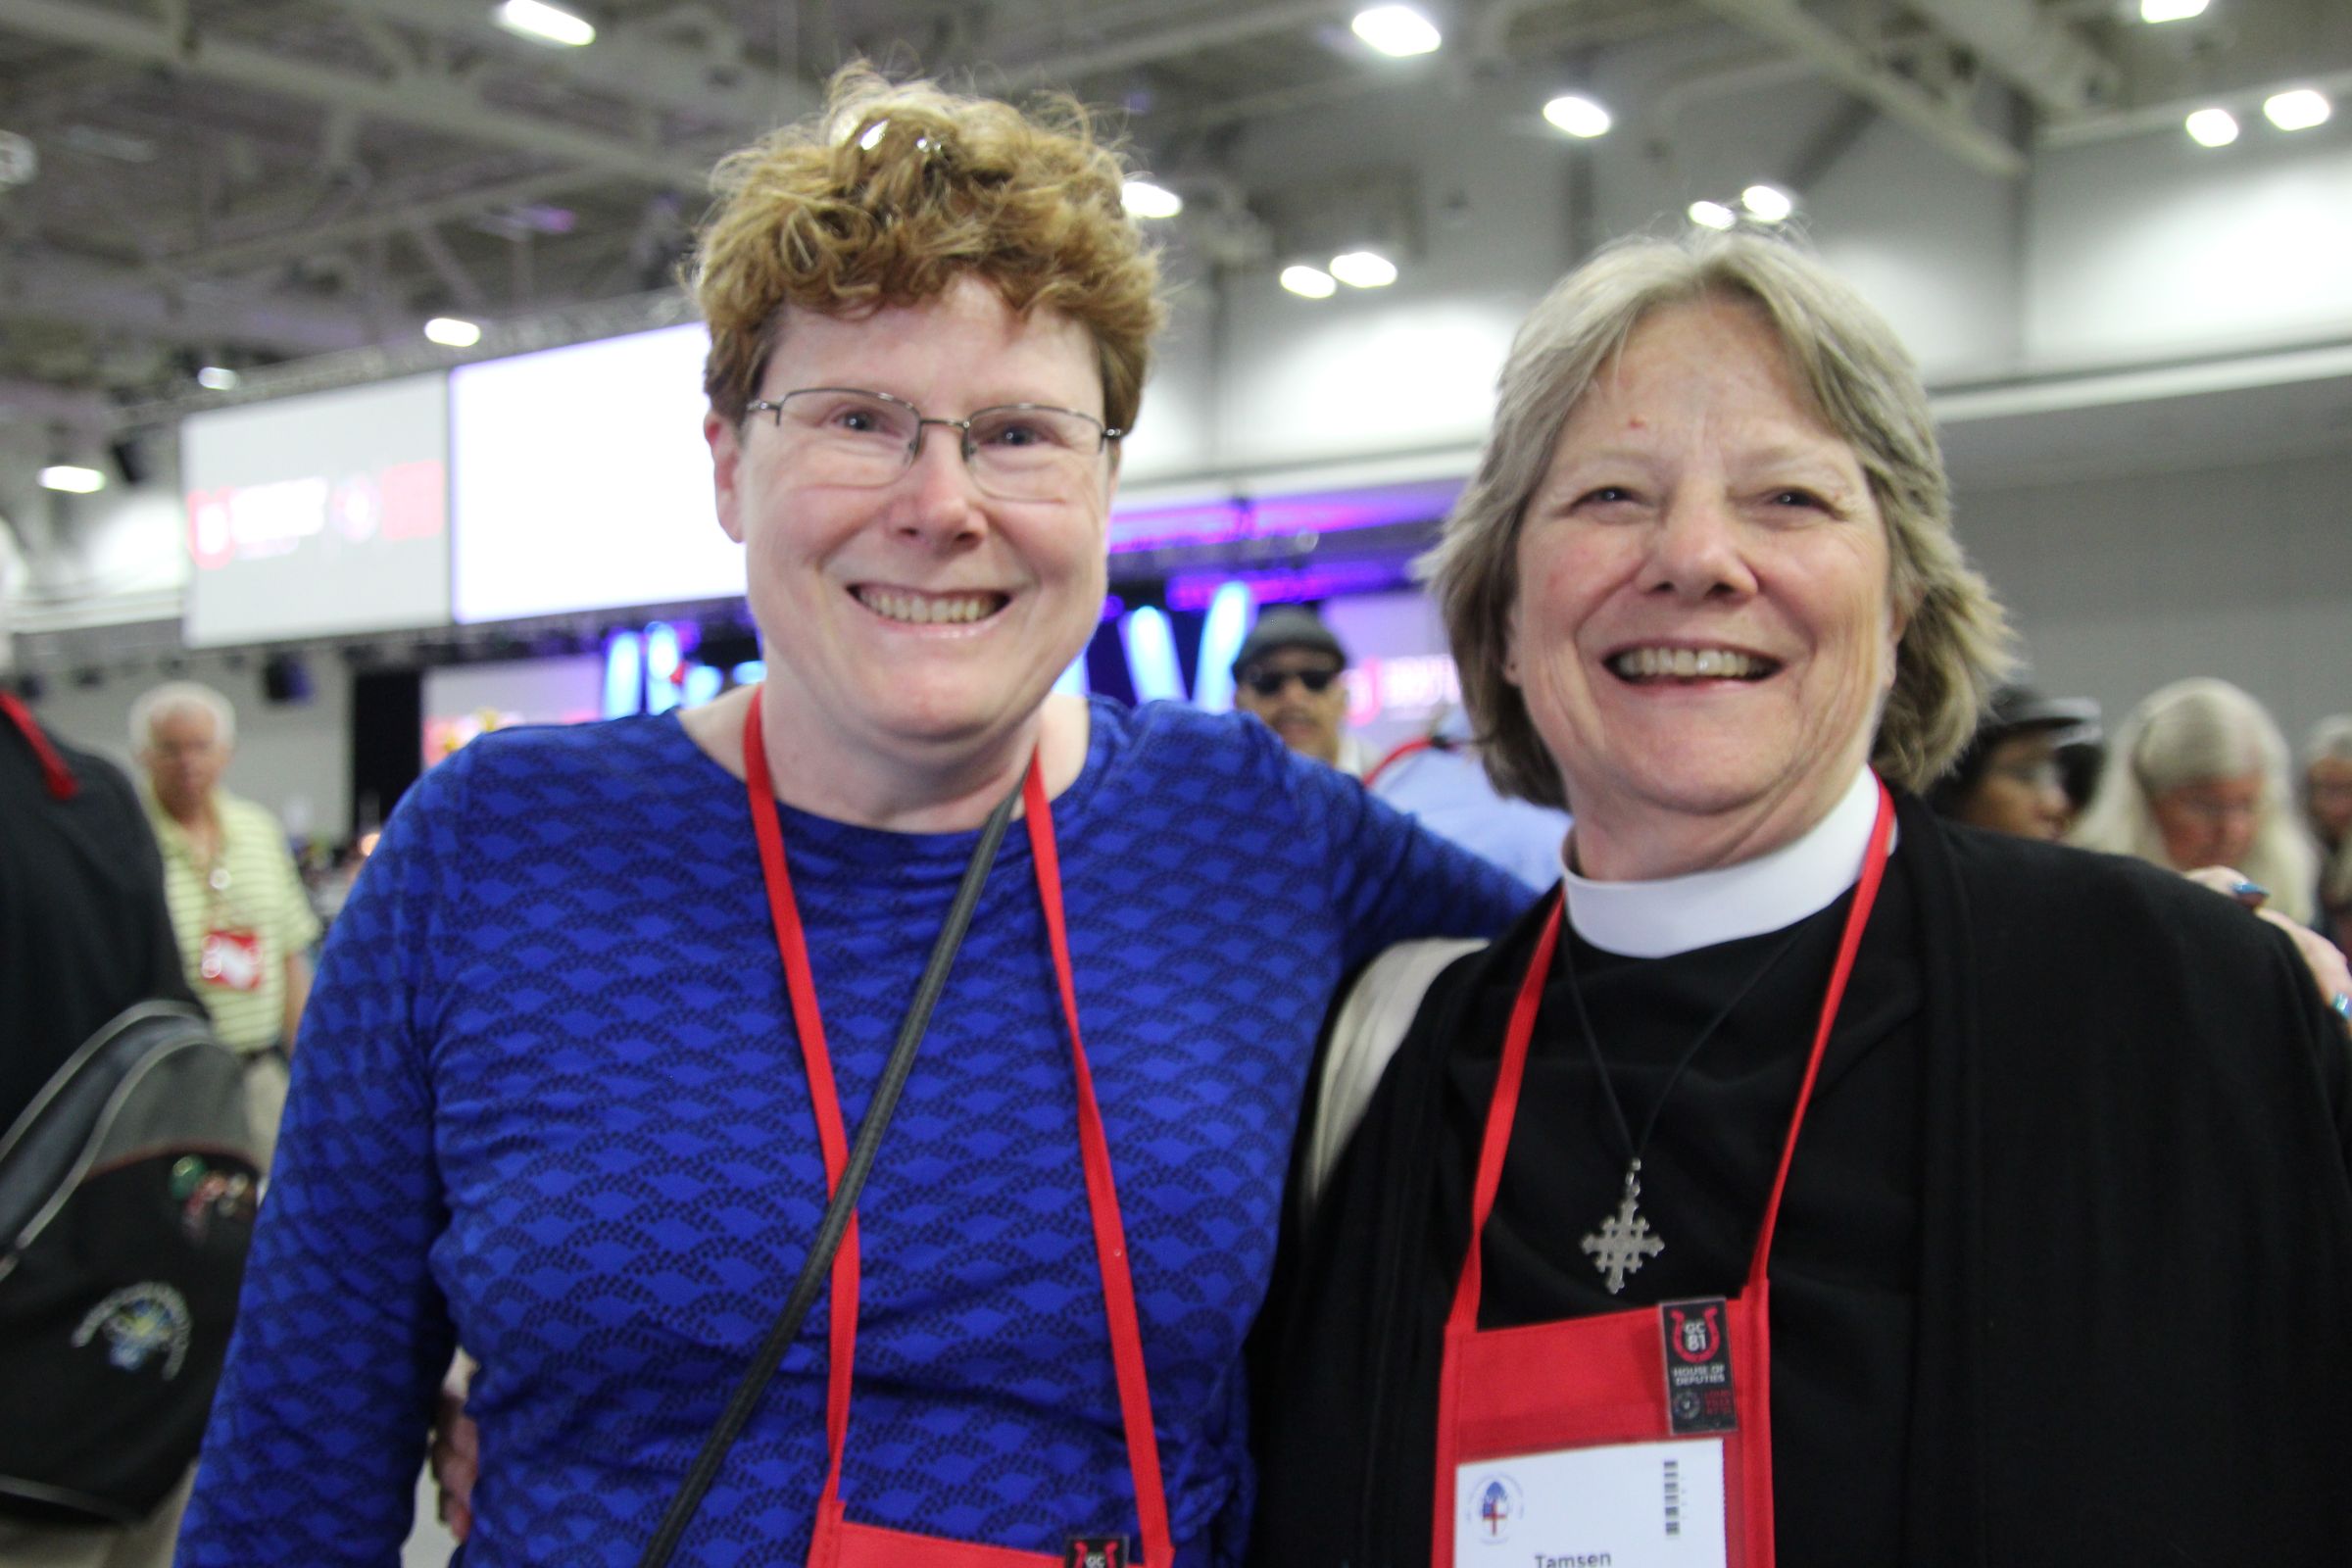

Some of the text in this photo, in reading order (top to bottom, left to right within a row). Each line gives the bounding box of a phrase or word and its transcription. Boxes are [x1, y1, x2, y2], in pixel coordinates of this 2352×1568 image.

[1685, 1321, 1706, 1334] GC
[1688, 1334, 1706, 1351] 81
[1673, 1363, 1725, 1377] HOUSE OF
[1676, 1374, 1726, 1387] DEPUTIES
[1535, 1552, 1612, 1568] Tamsen
